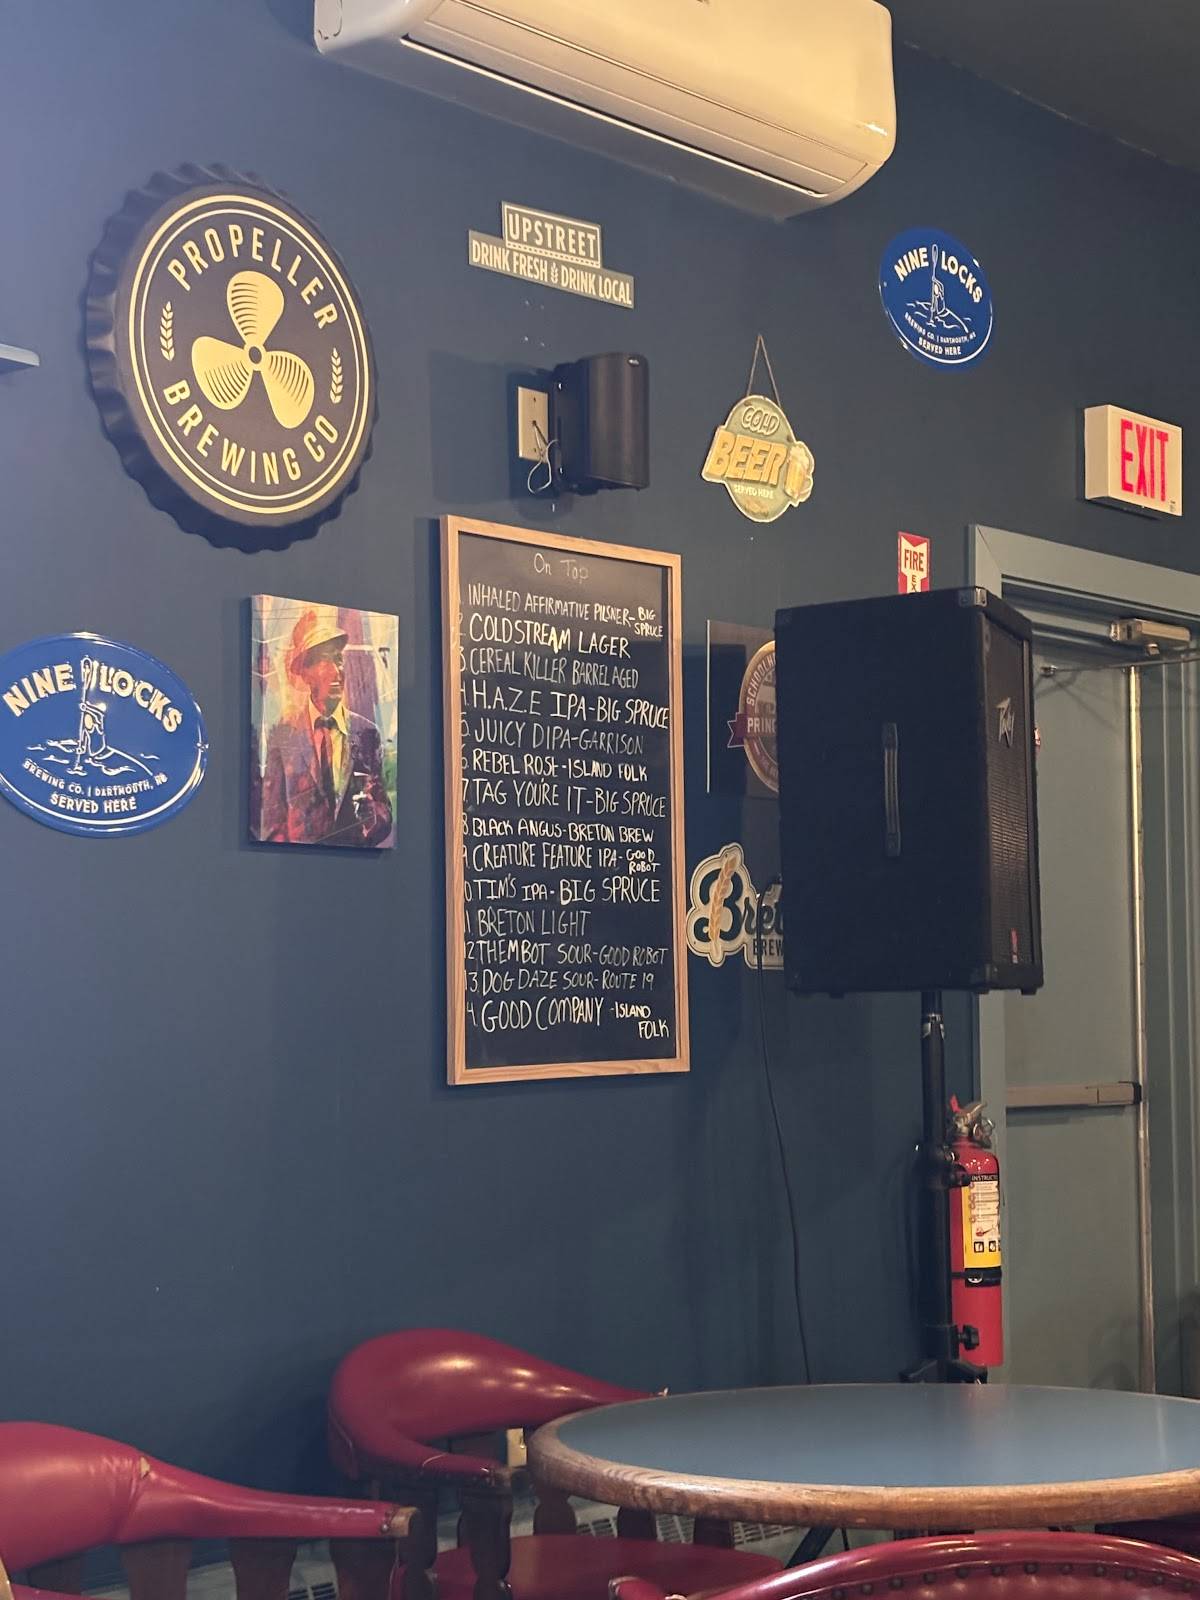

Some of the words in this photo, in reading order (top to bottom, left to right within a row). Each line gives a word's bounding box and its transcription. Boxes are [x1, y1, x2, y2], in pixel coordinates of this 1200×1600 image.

[507, 213, 597, 258] UPSTREET
[167, 224, 338, 329] PROPELLER
[472, 239, 511, 272] DRINK
[512, 251, 549, 283] FRESH
[560, 264, 597, 296] DRINK
[599, 276, 632, 306] LOCAL
[893, 247, 930, 282] NINE
[940, 250, 983, 303] LOCKS
[918, 337, 943, 355] SERVED
[944, 346, 962, 356] HERE
[162, 379, 301, 486] BREWING
[303, 414, 339, 463] CO
[742, 405, 780, 436] COLD
[704, 429, 788, 487] BEER
[1120, 417, 1169, 503] EXIT
[533, 552, 552, 576] On
[560, 558, 590, 584] Tap
[904, 549, 924, 572] FIRE
[468, 582, 521, 613] INHALED
[524, 592, 590, 621] AFFIRMATIVE
[637, 606, 657, 622] BIG
[578, 630, 631, 660] LAGER
[634, 622, 664, 638] SPRUCE
[470, 648, 522, 676] CEREAL
[524, 651, 568, 684] KILLER
[746, 652, 776, 706] SCHOOLH
[2, 662, 77, 718] NINE
[99, 664, 183, 733] LOCKS
[625, 698, 670, 730] SPRUCE
[474, 717, 526, 748] JUICY
[22, 757, 66, 790] BREWING
[472, 747, 520, 775] REBEL
[618, 763, 648, 782] FOLK
[50, 791, 99, 814] SERVED
[103, 795, 138, 814] HERE
[472, 777, 508, 806] TAG
[620, 790, 667, 818] SPRUCE
[472, 817, 514, 838] BLACK
[618, 826, 654, 843] BREW
[472, 841, 537, 872] CREATURE
[542, 841, 593, 870] FEATURE
[626, 848, 655, 863] GOOD
[628, 862, 661, 875] ROBOT
[472, 872, 517, 900] TIM'S
[601, 875, 660, 904] SPRUCE
[477, 906, 535, 937] BRETON
[541, 910, 591, 936] LIGHT
[632, 946, 669, 967] ROBOT
[482, 969, 515, 996] DOG
[517, 968, 559, 990] DAZE
[641, 972, 655, 991] 19
[481, 999, 532, 1033] GOOD
[535, 996, 605, 1031] COMPANY
[638, 1019, 670, 1040] FOLK
